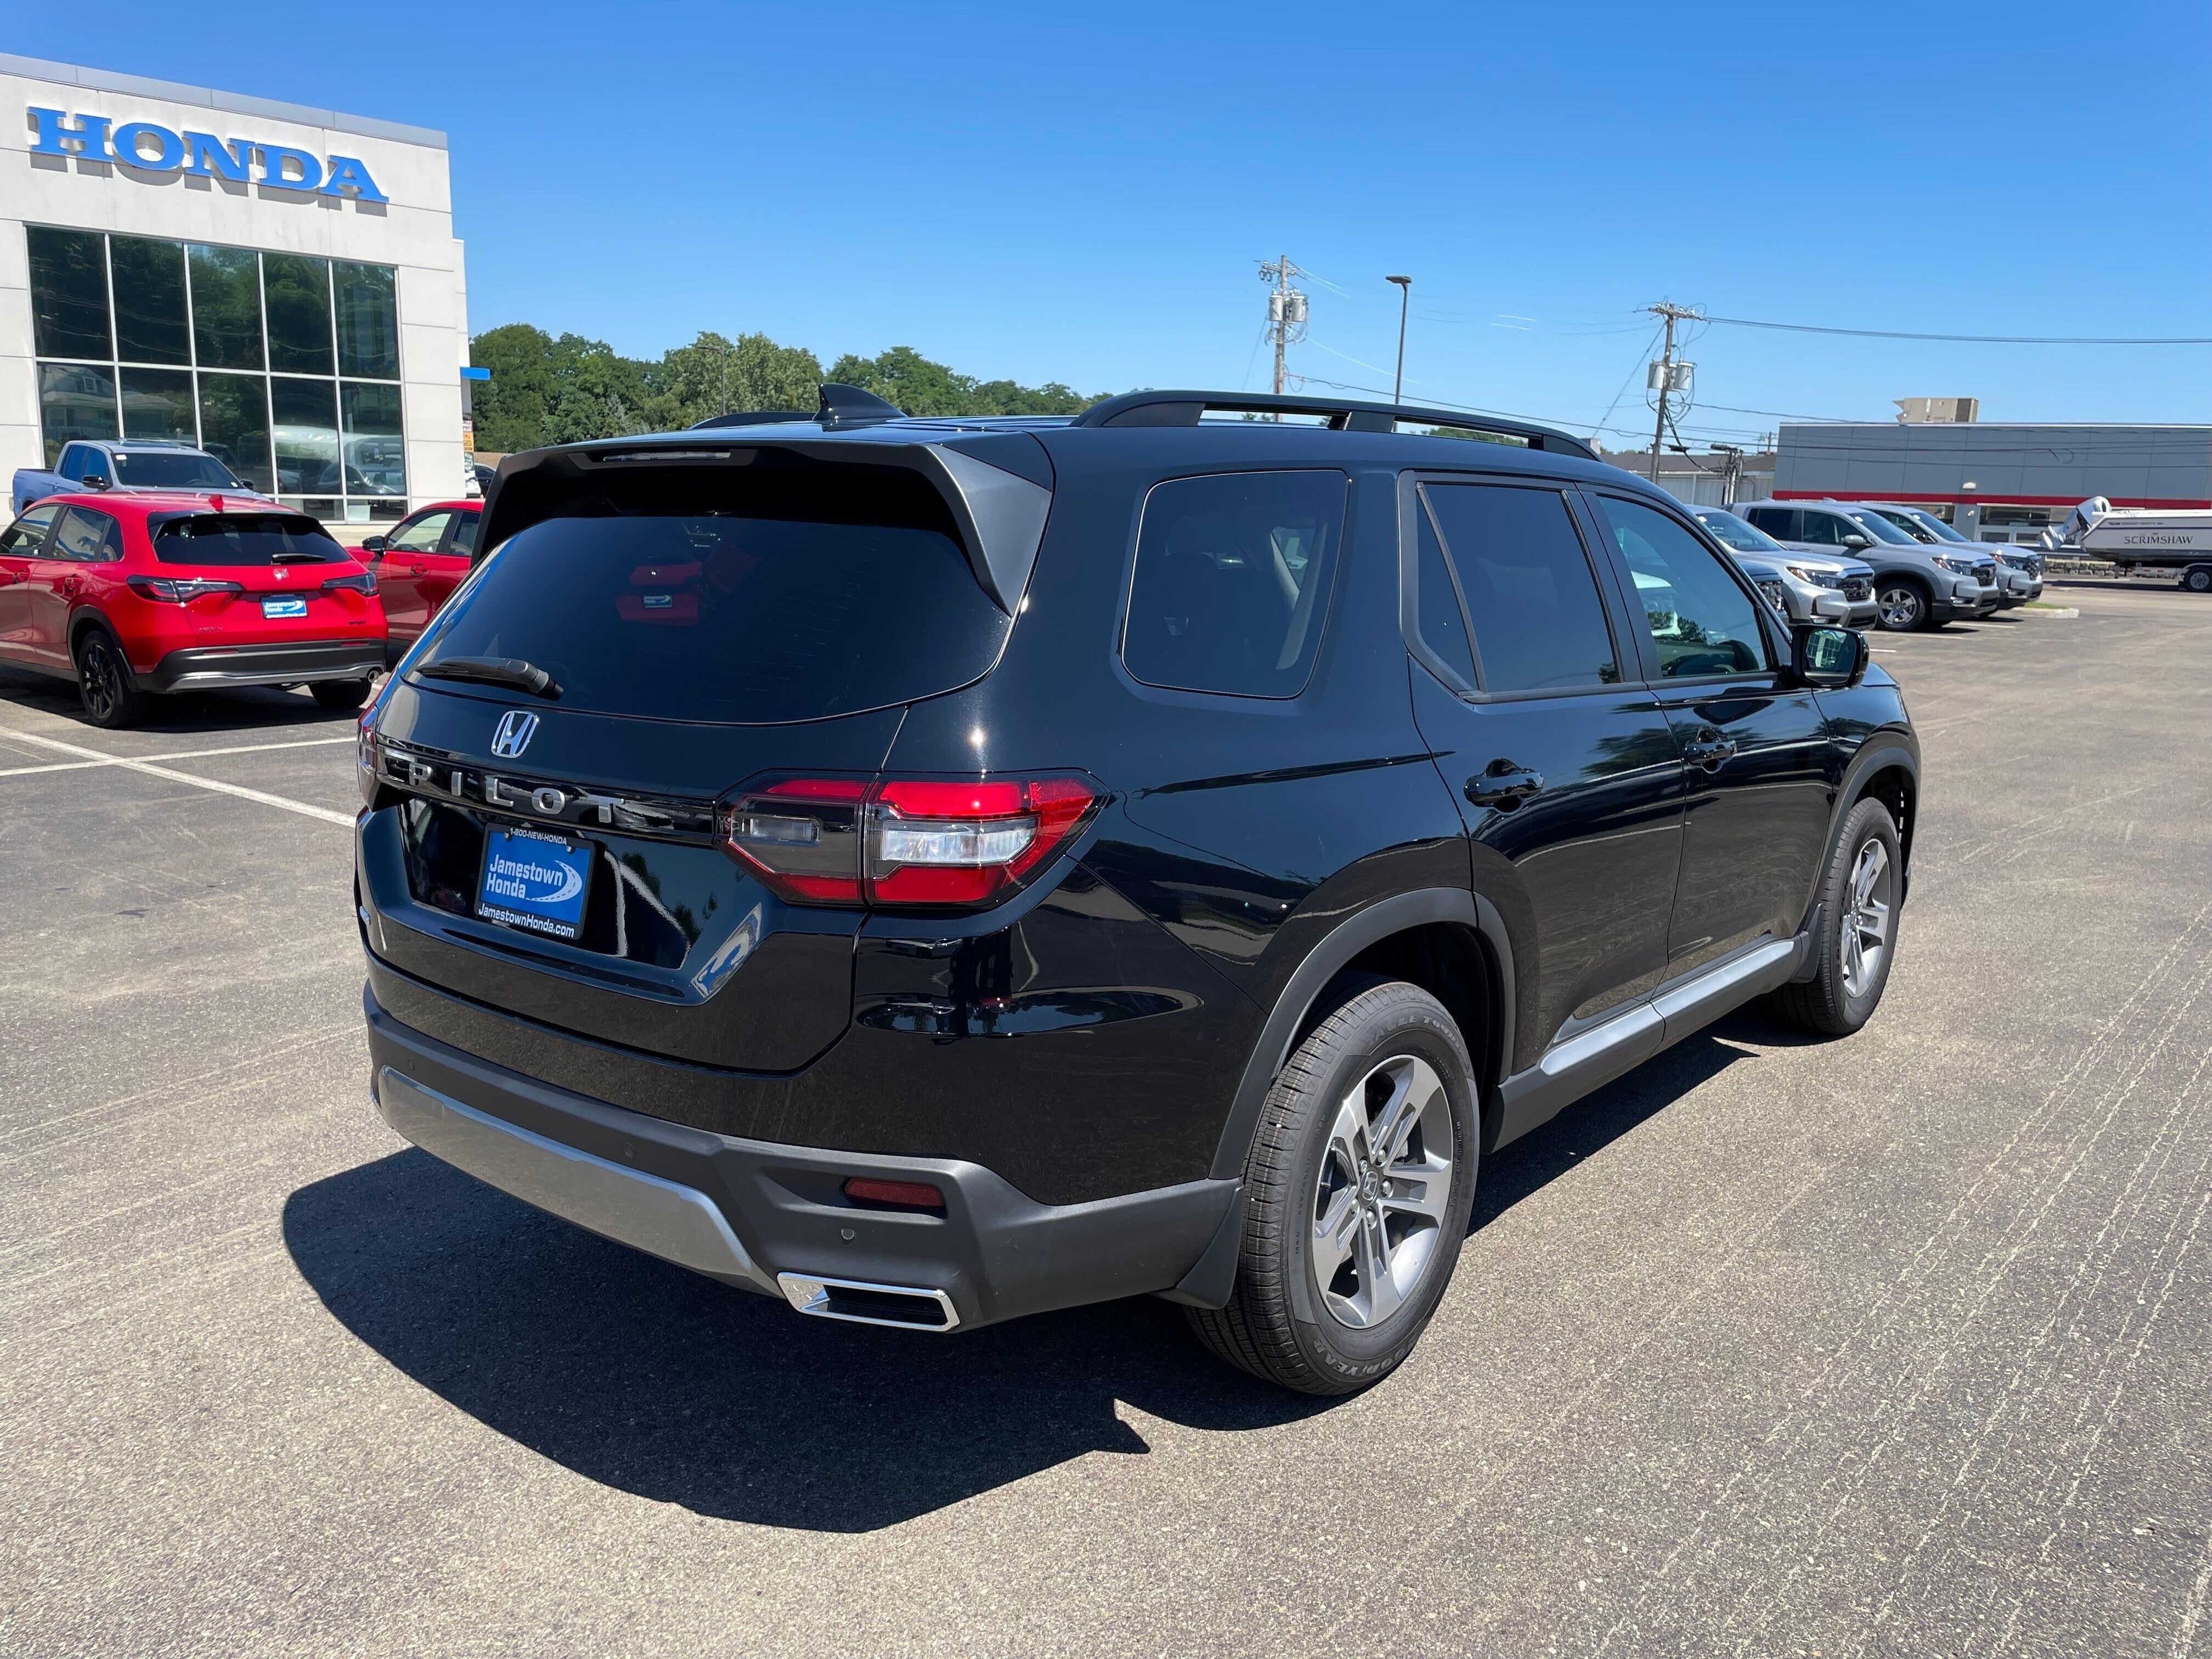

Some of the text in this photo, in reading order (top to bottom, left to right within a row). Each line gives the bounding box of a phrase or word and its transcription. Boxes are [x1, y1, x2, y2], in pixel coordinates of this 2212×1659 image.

[28, 106, 389, 203] HONDA
[2124, 535, 2193, 545] SCRIMSHAW
[408, 761, 625, 823] PILOT
[510, 827, 567, 845] 1-800-NEW-HONDA
[486, 872, 526, 899] Honda
[489, 854, 563, 887] Jamestown
[478, 903, 575, 938] JamestownHonda.com
